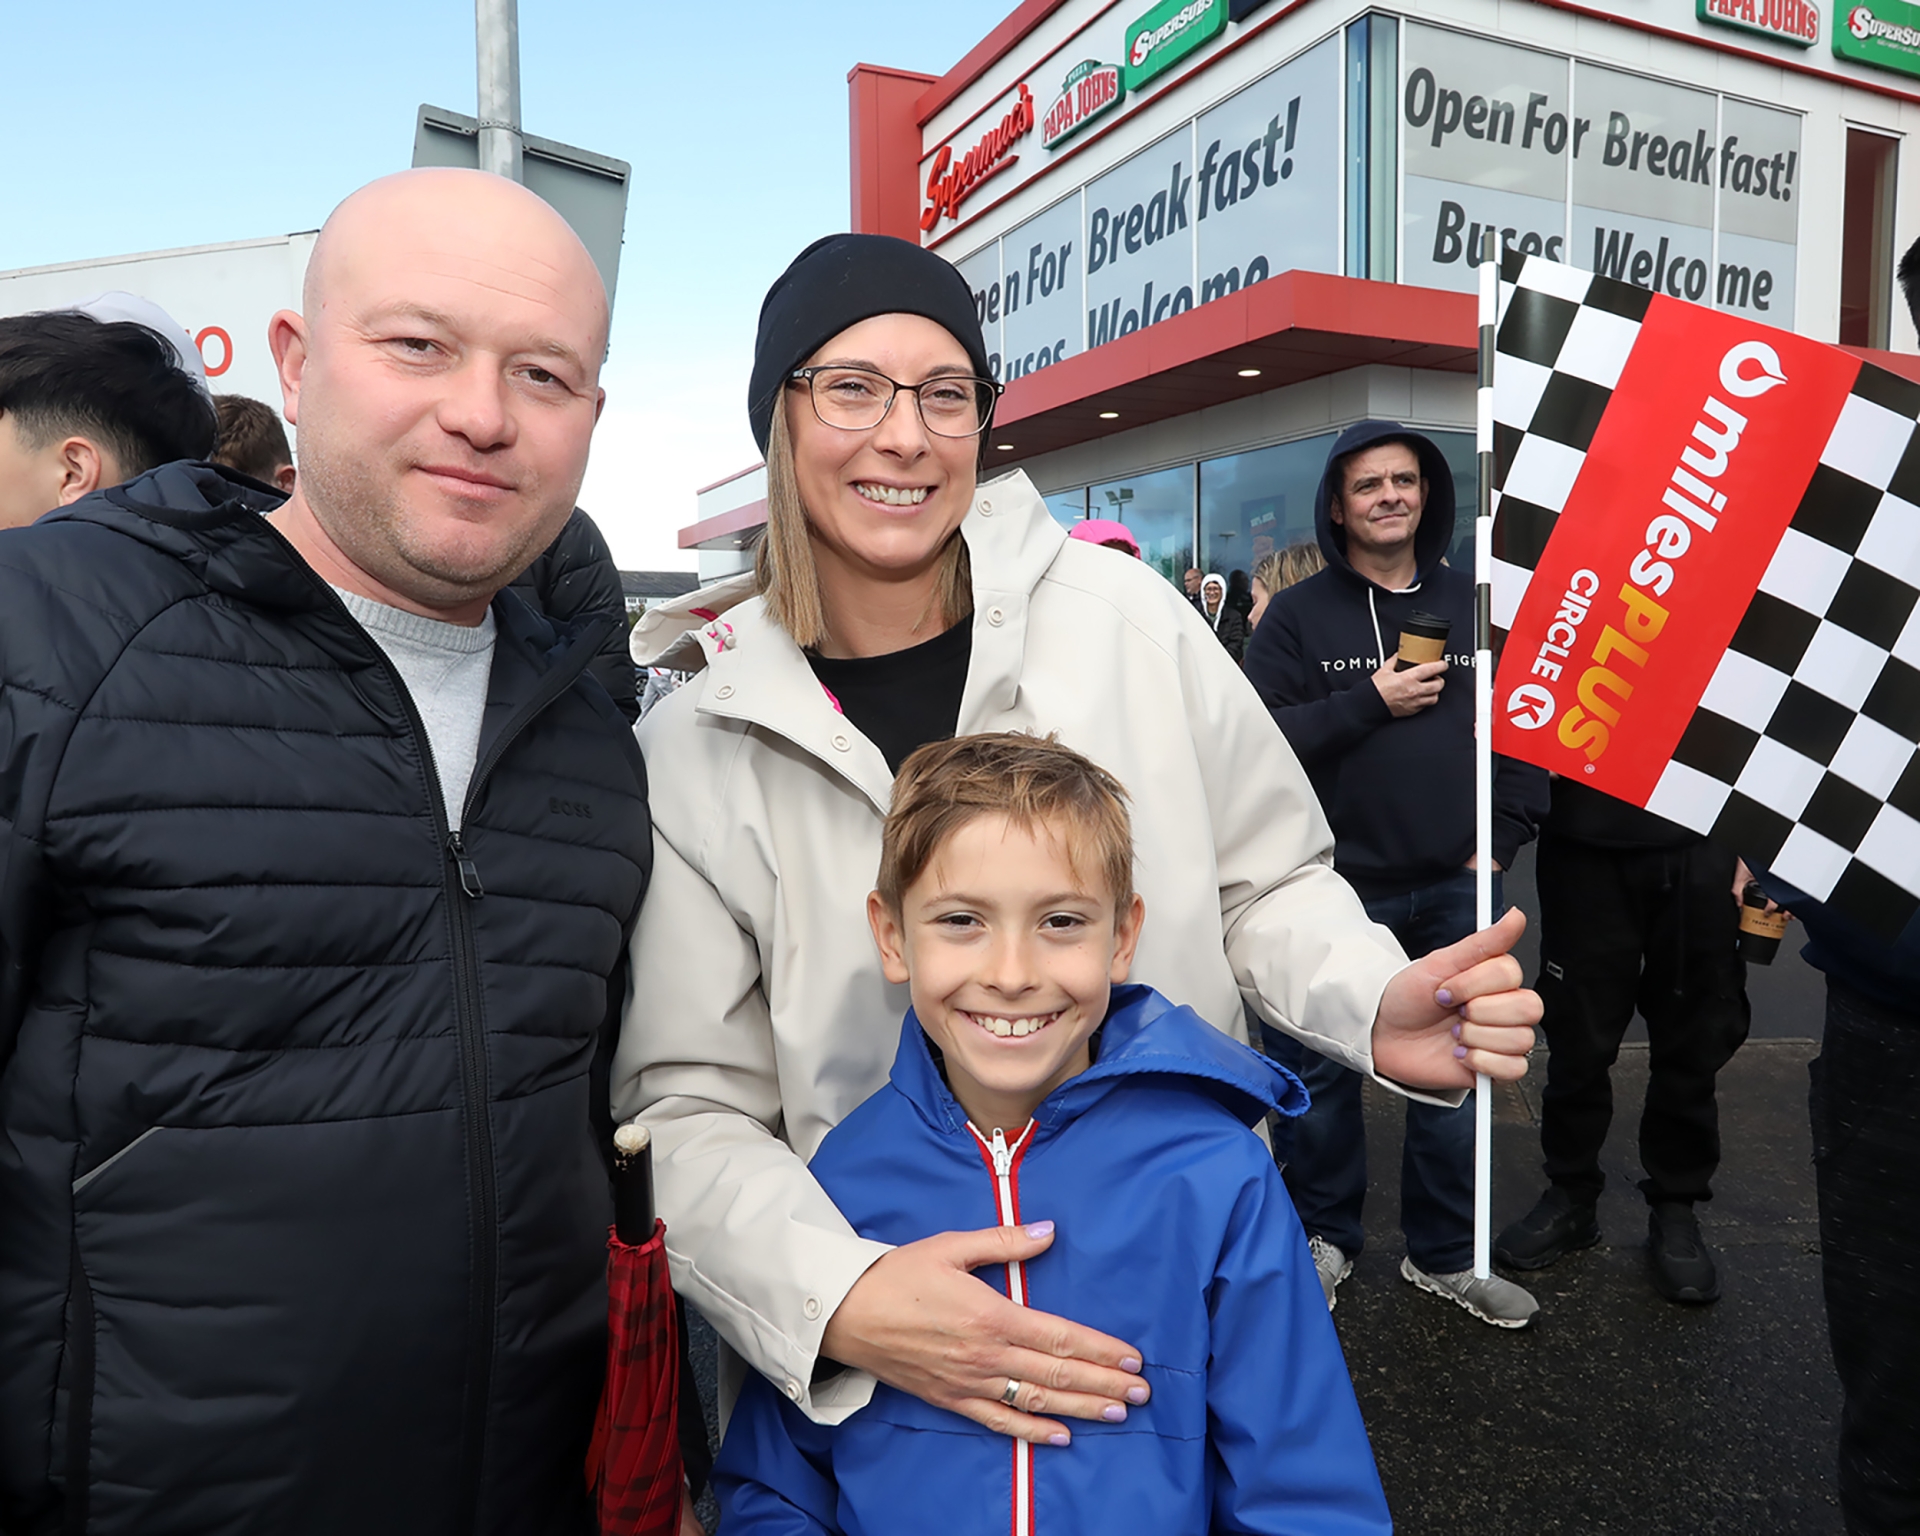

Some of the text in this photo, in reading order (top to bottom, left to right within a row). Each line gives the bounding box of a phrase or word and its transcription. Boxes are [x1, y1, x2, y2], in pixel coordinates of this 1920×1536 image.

[1758, 0, 1817, 40] JOHNS
[920, 82, 1035, 232] Supermac's
[1043, 70, 1116, 144] PAPA JOHNS
[1404, 67, 1798, 202] Open For Breakfast!
[972, 96, 1301, 328] pen For Breakfast!
[1321, 656, 1378, 673] TOMM
[1507, 568, 1600, 727] CIRCLE K
[548, 796, 593, 820] BOSS
